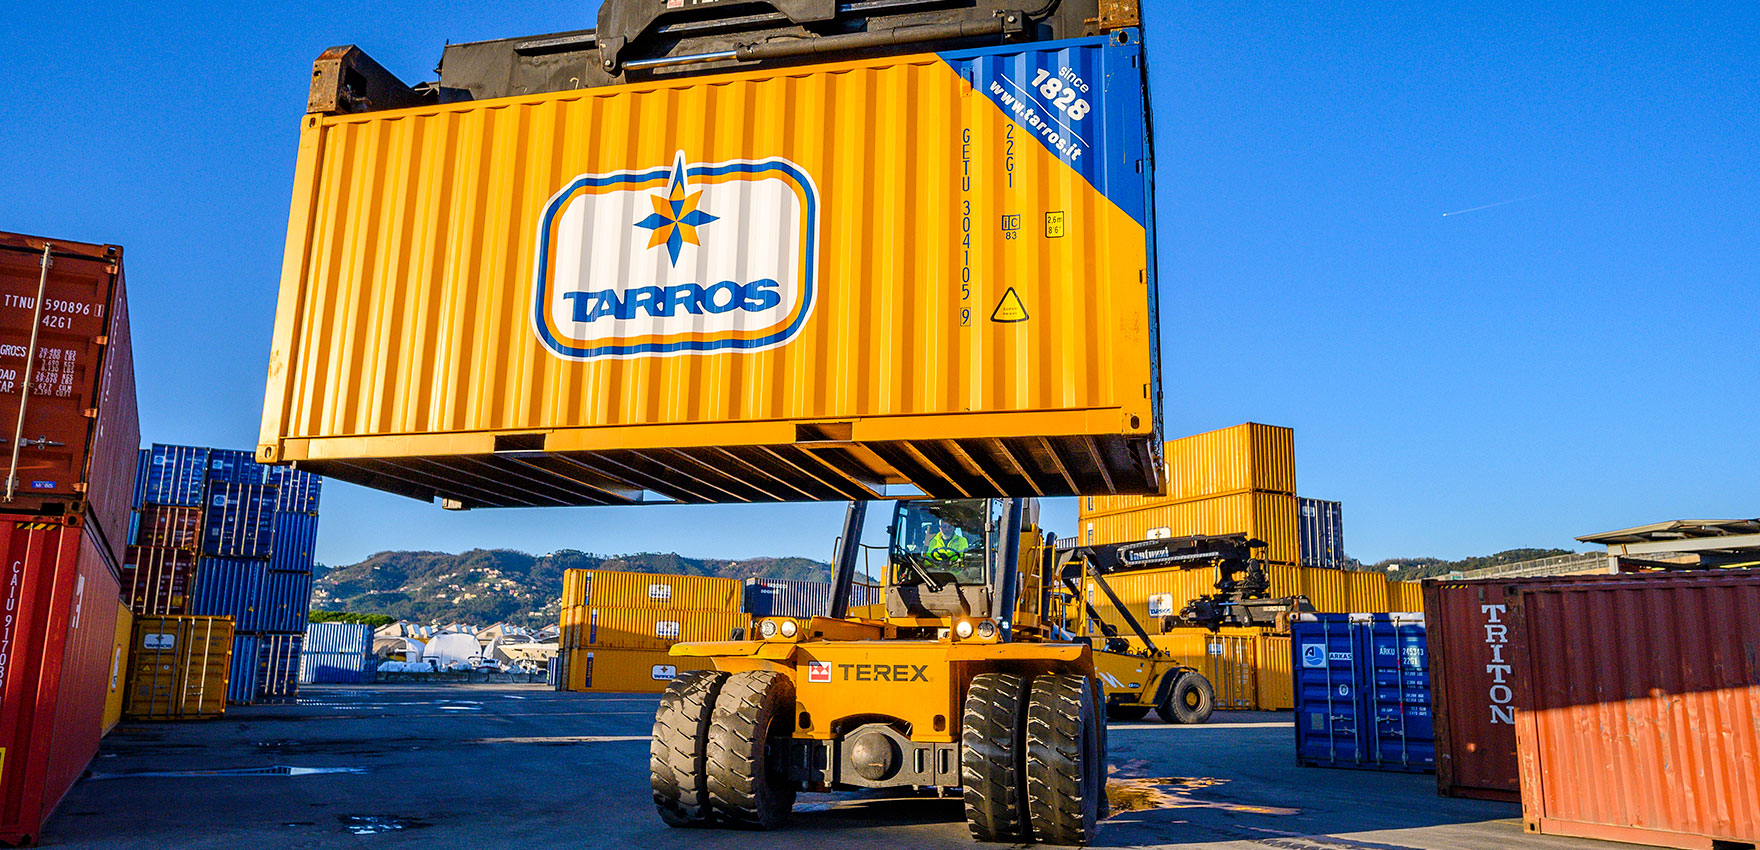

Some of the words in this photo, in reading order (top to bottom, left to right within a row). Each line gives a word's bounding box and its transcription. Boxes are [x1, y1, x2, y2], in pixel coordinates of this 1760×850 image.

[1031, 68, 1090, 121] 1828
[1058, 66, 1089, 93] since
[989, 81, 1082, 161] www.tarros.it
[962, 128, 970, 192] GETU
[1006, 123, 1014, 188] 22G1
[962, 200, 971, 300] 304105
[1005, 231, 1017, 240] 83
[5, 294, 35, 309] TTNU
[45, 298, 90, 315] 590896
[563, 278, 781, 323] TARROS
[961, 308, 970, 325] 9
[42, 315, 72, 329] 42G1
[0, 344, 27, 357] GROSS
[0, 381, 14, 393] AP.
[6, 561, 21, 611] CAIU
[838, 664, 929, 682] TEREX
[1481, 604, 1515, 725] TRITON
